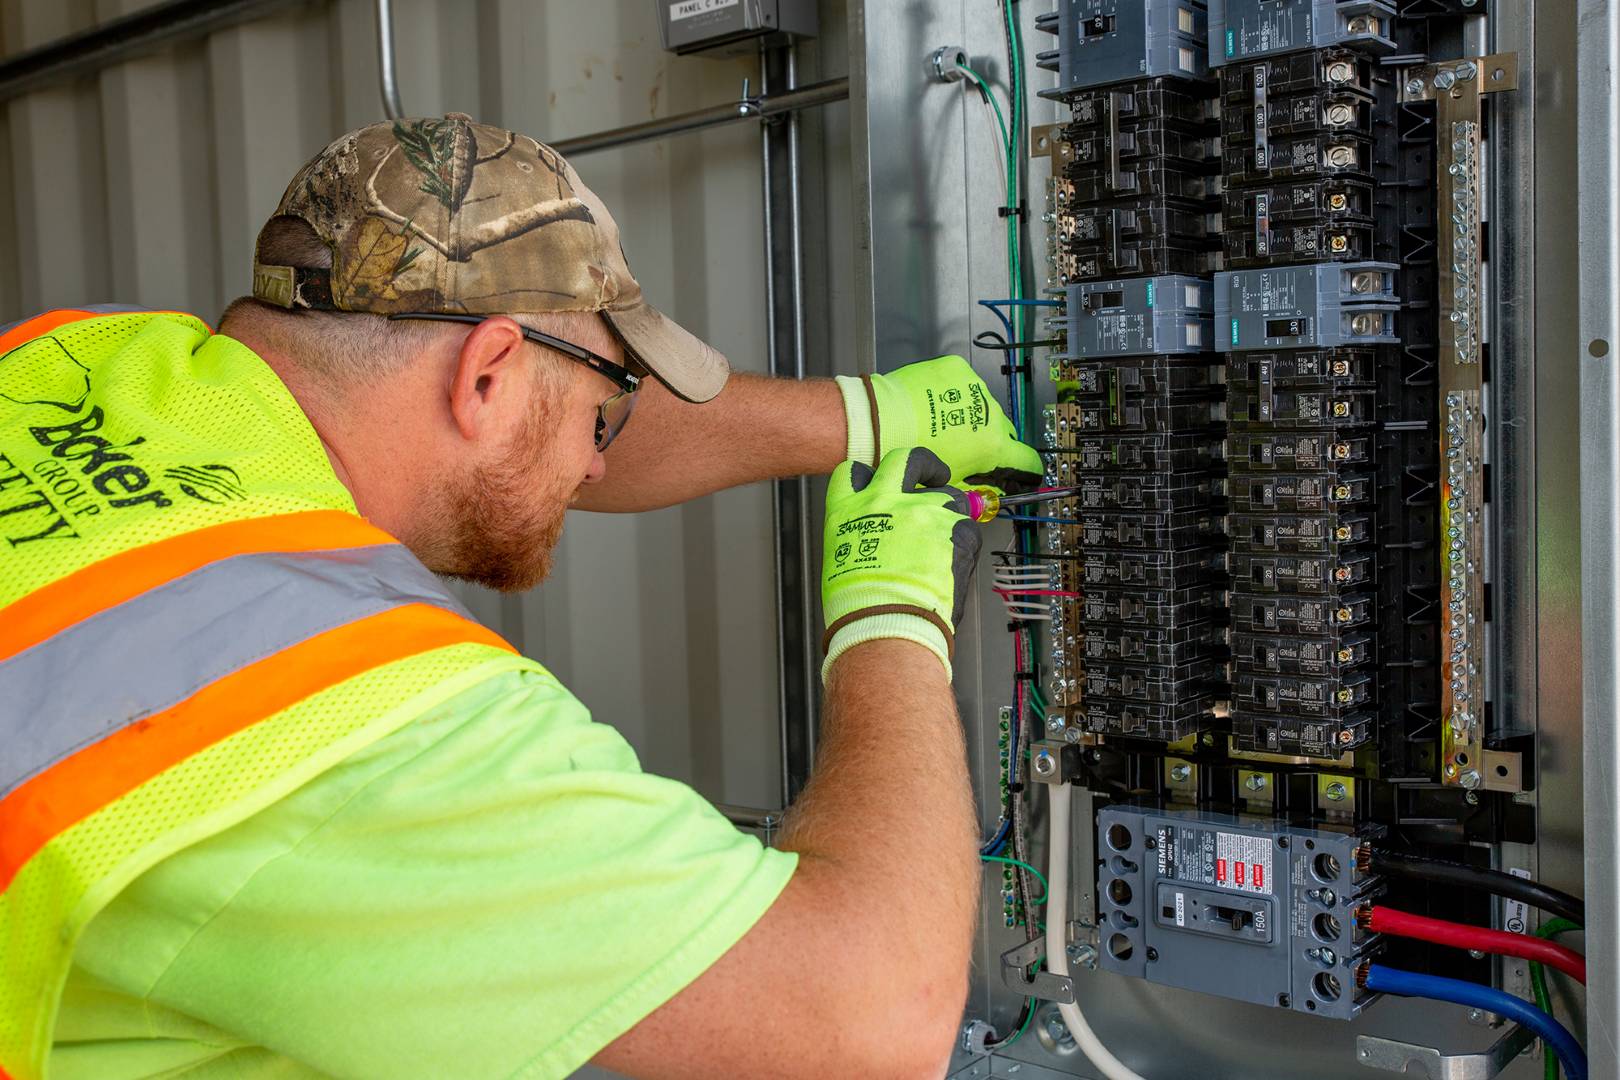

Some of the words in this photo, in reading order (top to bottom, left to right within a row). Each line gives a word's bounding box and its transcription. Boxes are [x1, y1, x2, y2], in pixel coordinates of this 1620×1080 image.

[680, 2, 701, 15] PANEL
[1256, 73, 1264, 88] 100
[1256, 113, 1264, 125] 100
[1258, 202, 1266, 212] 20
[1258, 242, 1266, 251] 20
[1290, 321, 1298, 332] 30
[1262, 366, 1268, 375] 40
[948, 391, 956, 402] A2
[969, 383, 984, 425] SAMURAI
[1262, 405, 1269, 415] 40
[1264, 447, 1270, 457] 20
[33, 459, 100, 517] GROUP
[1264, 488, 1271, 498] 20
[837, 519, 888, 537] SAMURAI
[1265, 529, 1272, 538] 20
[837, 547, 849, 558] A2
[1265, 569, 1271, 579] 20
[1266, 611, 1273, 620] 20
[1267, 652, 1274, 662] 20
[1267, 691, 1274, 700] 20
[1269, 732, 1276, 741] 20
[1158, 829, 1166, 874] SIEMENS
[1256, 910, 1265, 932] 150A
